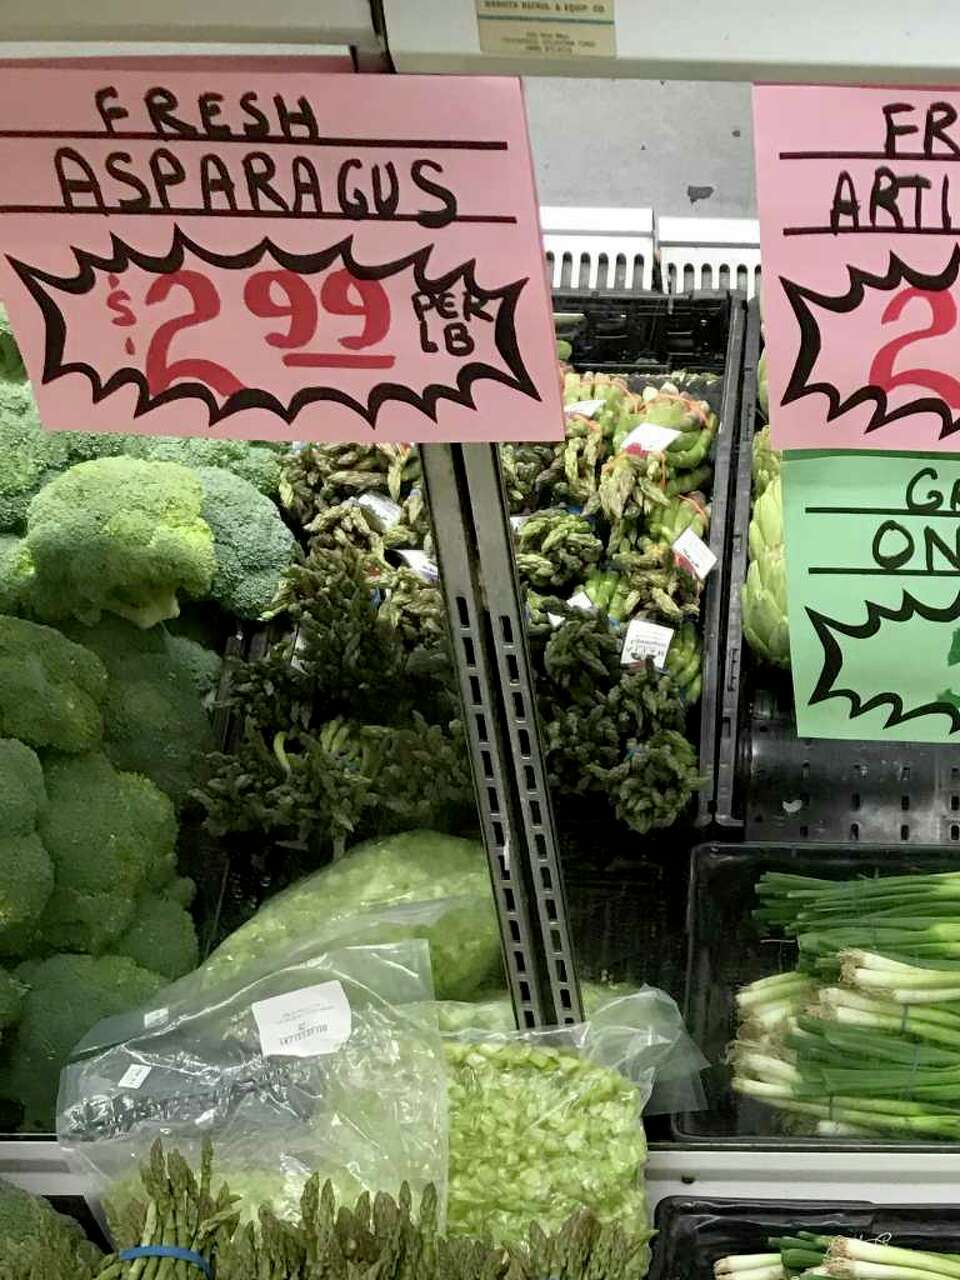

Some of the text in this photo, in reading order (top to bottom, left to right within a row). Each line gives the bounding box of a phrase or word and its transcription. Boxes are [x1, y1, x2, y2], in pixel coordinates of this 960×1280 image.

[94, 86, 319, 140] FRESH
[54, 146, 458, 228] ASPARAGUS
[411, 290, 497, 323] PER
[420, 321, 475, 357] LB
